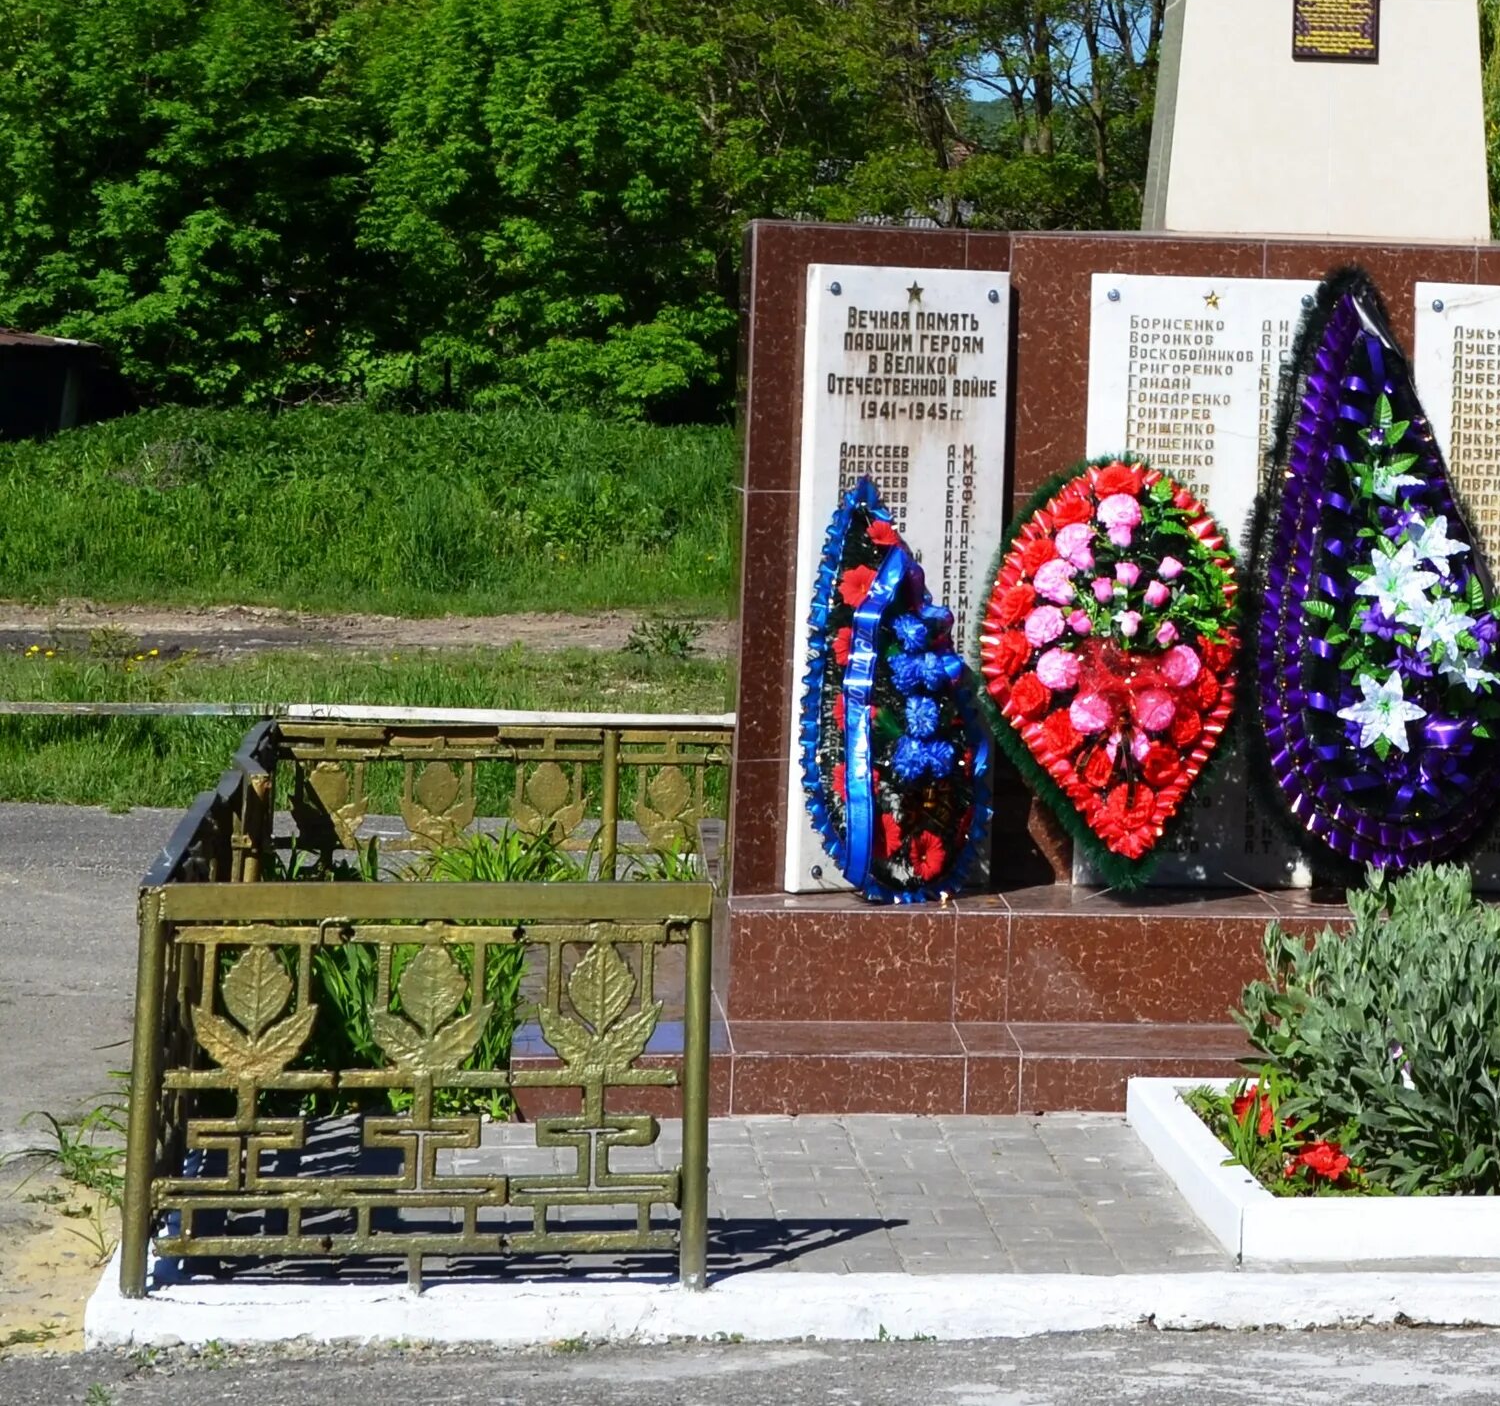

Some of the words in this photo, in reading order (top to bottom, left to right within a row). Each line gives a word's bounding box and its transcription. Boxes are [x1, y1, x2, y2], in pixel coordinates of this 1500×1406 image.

[916, 312, 979, 331] ПАМЯТЬ
[844, 332, 912, 353] ПАВШИМ
[920, 335, 984, 353] ГЕРОЯМ
[883, 352, 957, 375] ВЕЛИКОЙ
[828, 373, 946, 396] ОТЕЧЕСТВЕННОЙ
[953, 376, 997, 397] ВОЙНЕ
[840, 442, 909, 458] АЛЕКСЕЕВ
[839, 459, 909, 473] АЛЕКСЕЕВ
[839, 474, 908, 488] АЛСЕЕВ
